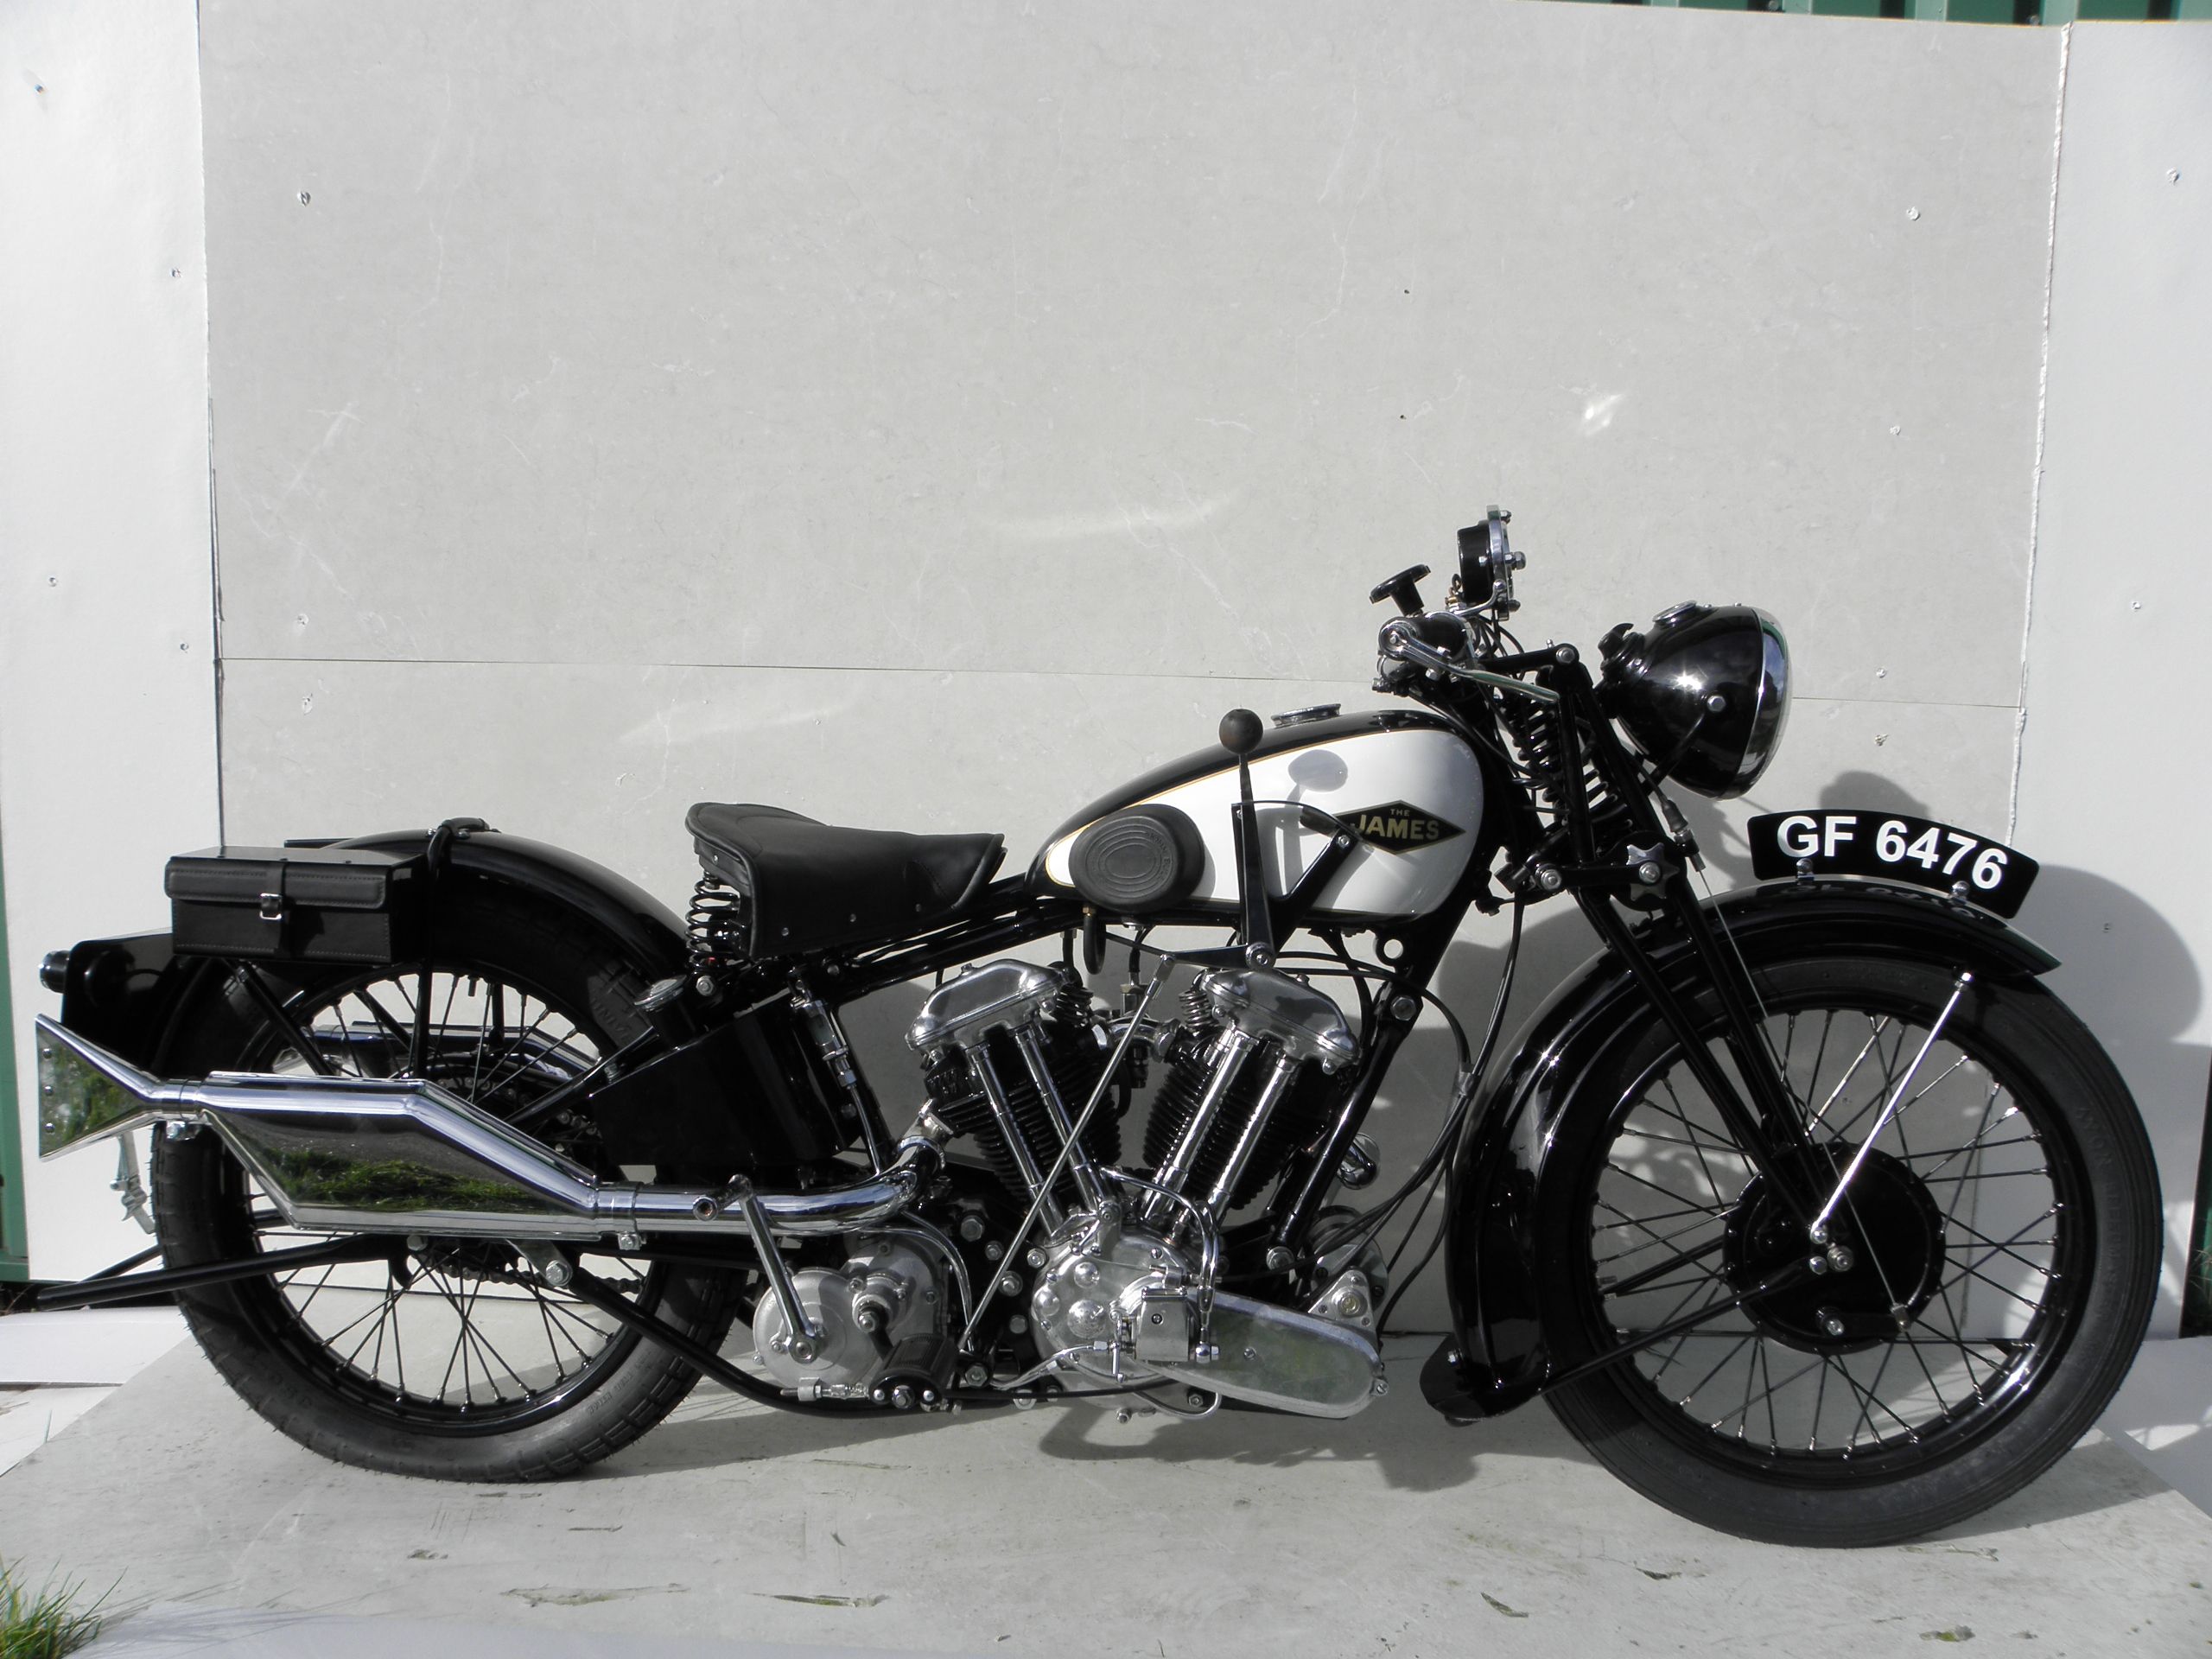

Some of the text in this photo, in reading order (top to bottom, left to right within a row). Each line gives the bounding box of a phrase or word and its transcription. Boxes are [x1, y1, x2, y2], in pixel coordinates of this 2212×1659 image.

[1389, 808, 1410, 817] THE
[1351, 814, 1440, 840] JAMES
[1777, 816, 2008, 890] GF 6476
